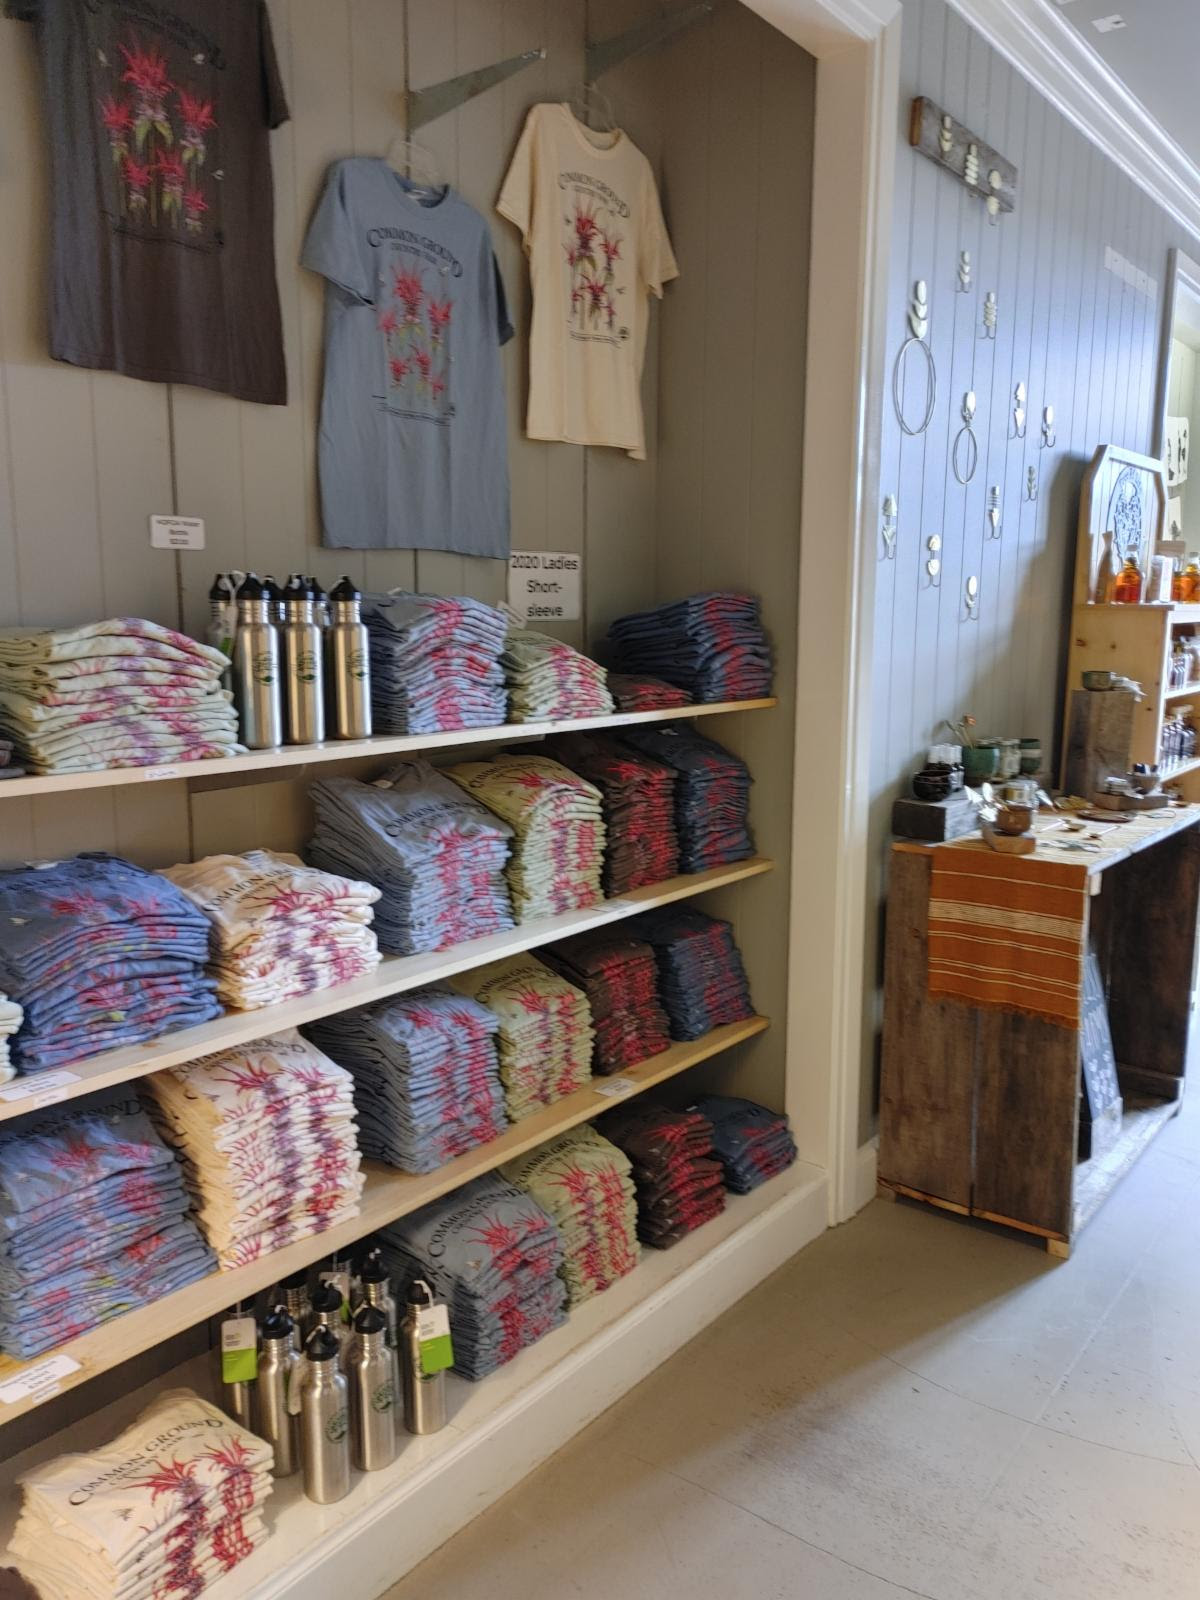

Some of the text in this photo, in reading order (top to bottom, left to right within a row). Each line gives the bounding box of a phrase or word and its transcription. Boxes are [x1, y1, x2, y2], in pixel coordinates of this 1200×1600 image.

[511, 554, 578, 570] 2020 Ladies
[527, 579, 563, 593] Short-
[527, 603, 563, 617] sleeve
[385, 807, 436, 838] COMMON
[427, 1207, 472, 1258] COMMON
[68, 1418, 223, 1506] COMMON GROUND
